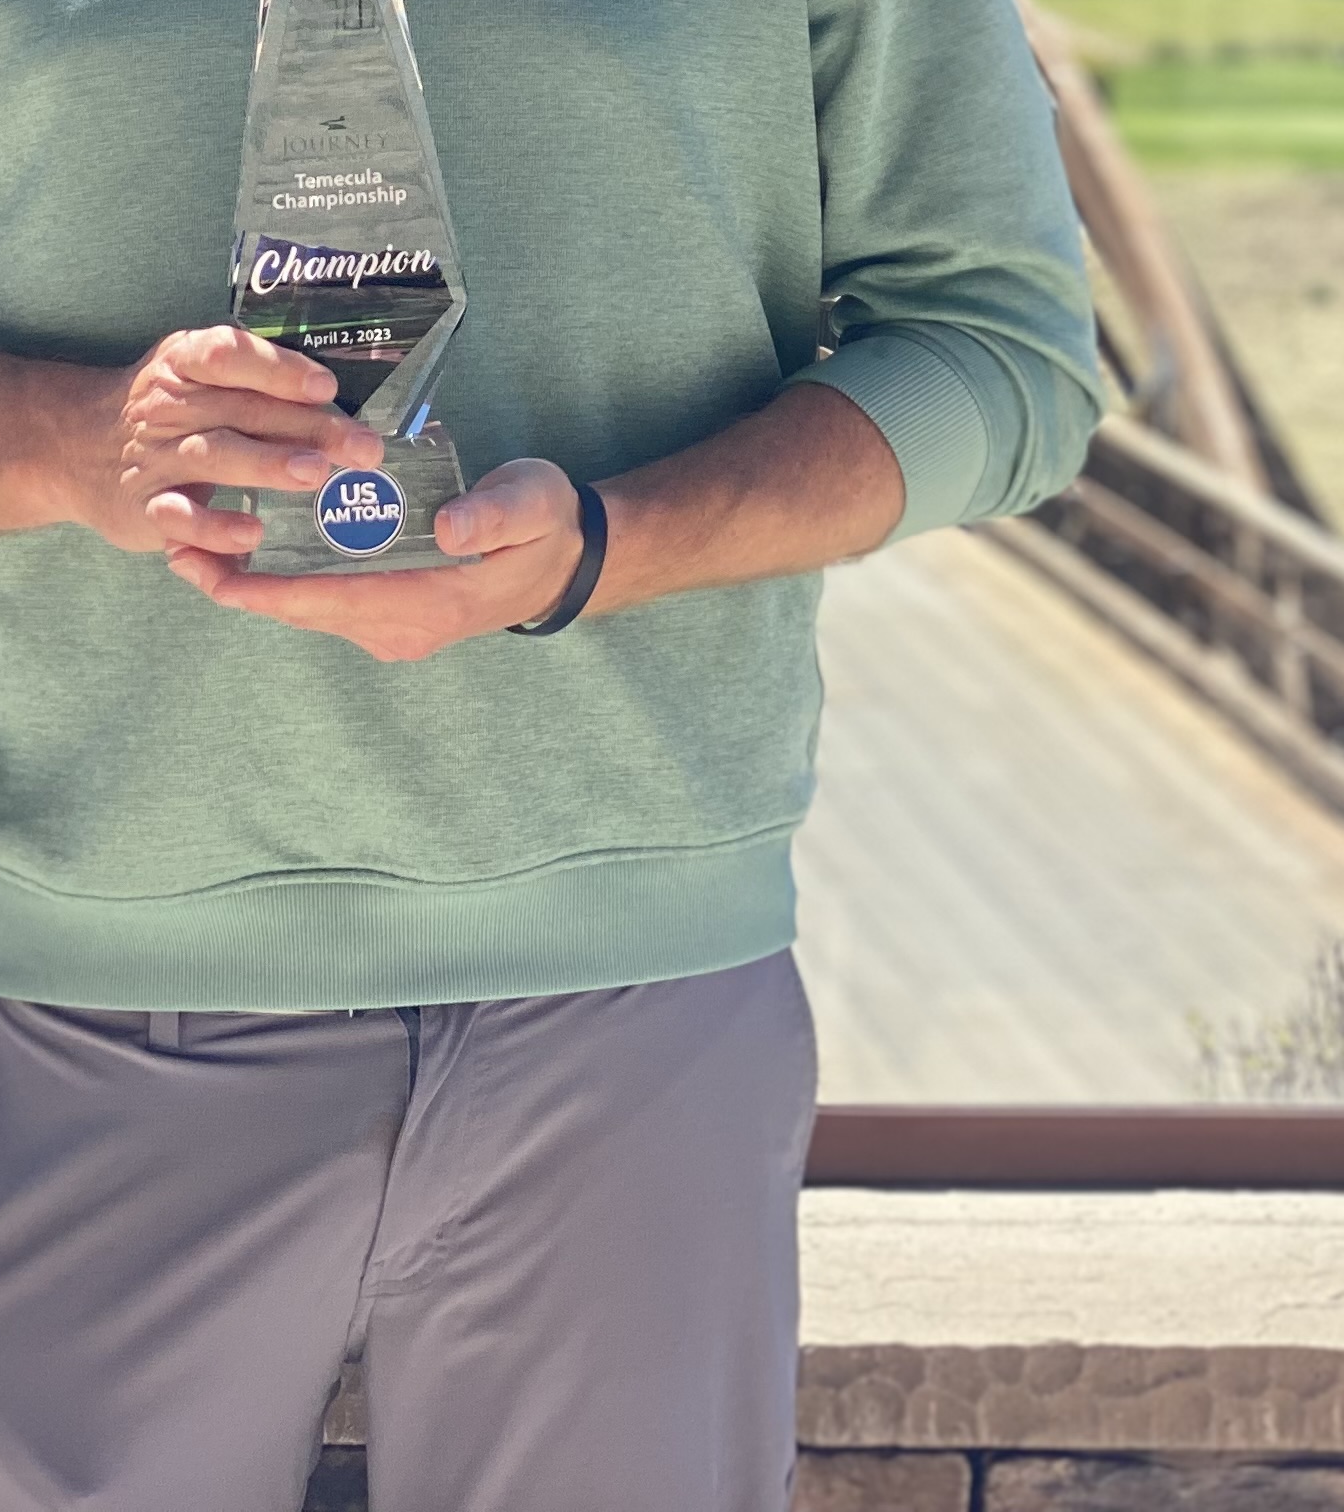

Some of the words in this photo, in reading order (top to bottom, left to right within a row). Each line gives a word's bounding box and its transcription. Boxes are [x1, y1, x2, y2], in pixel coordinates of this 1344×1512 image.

[283, 132, 389, 157] JOURNEY
[294, 167, 383, 189] Temecula
[272, 185, 407, 211] Championship
[250, 243, 436, 295] Champion
[303, 332, 337, 348] April
[340, 330, 354, 345] 2,
[357, 328, 392, 343] 2023
[351, 503, 400, 522] TOUR
